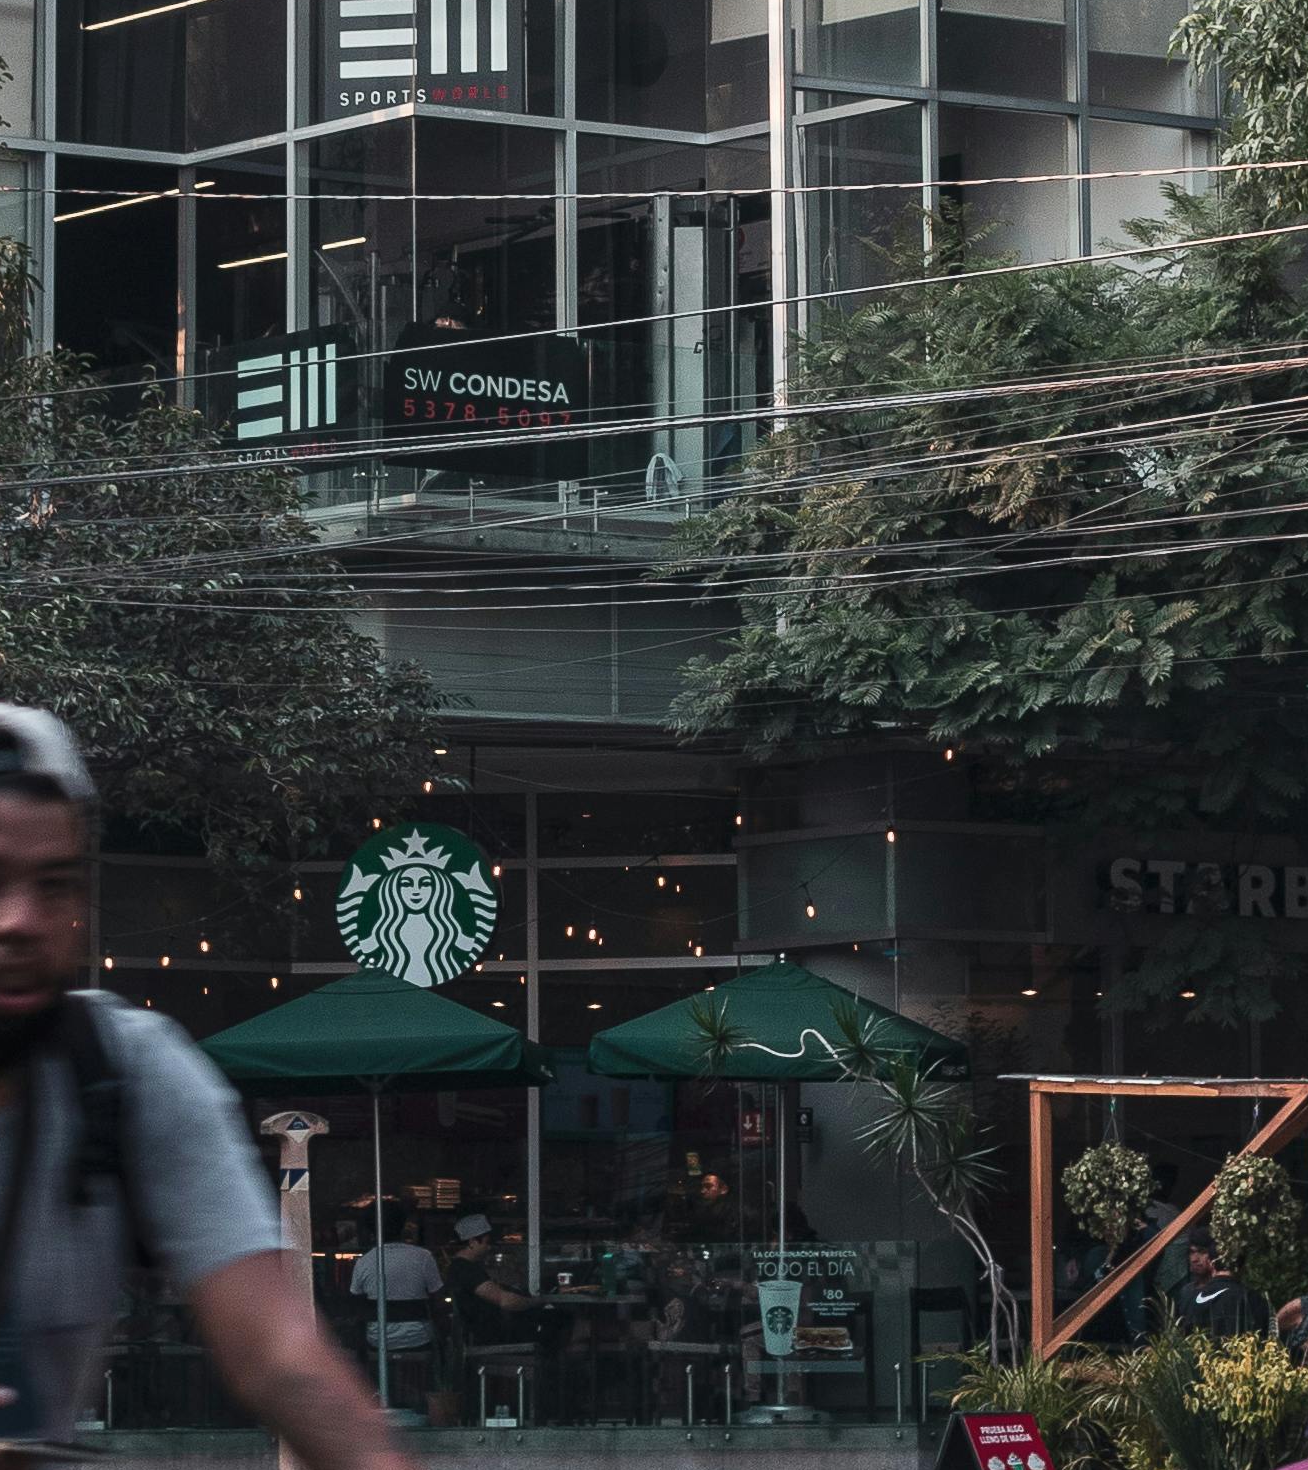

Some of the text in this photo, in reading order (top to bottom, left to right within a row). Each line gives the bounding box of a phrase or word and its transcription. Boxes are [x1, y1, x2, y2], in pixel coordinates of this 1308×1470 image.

[404, 367, 570, 404] SW CONDESA
[757, 1259, 855, 1277] TODO EL DÍA
